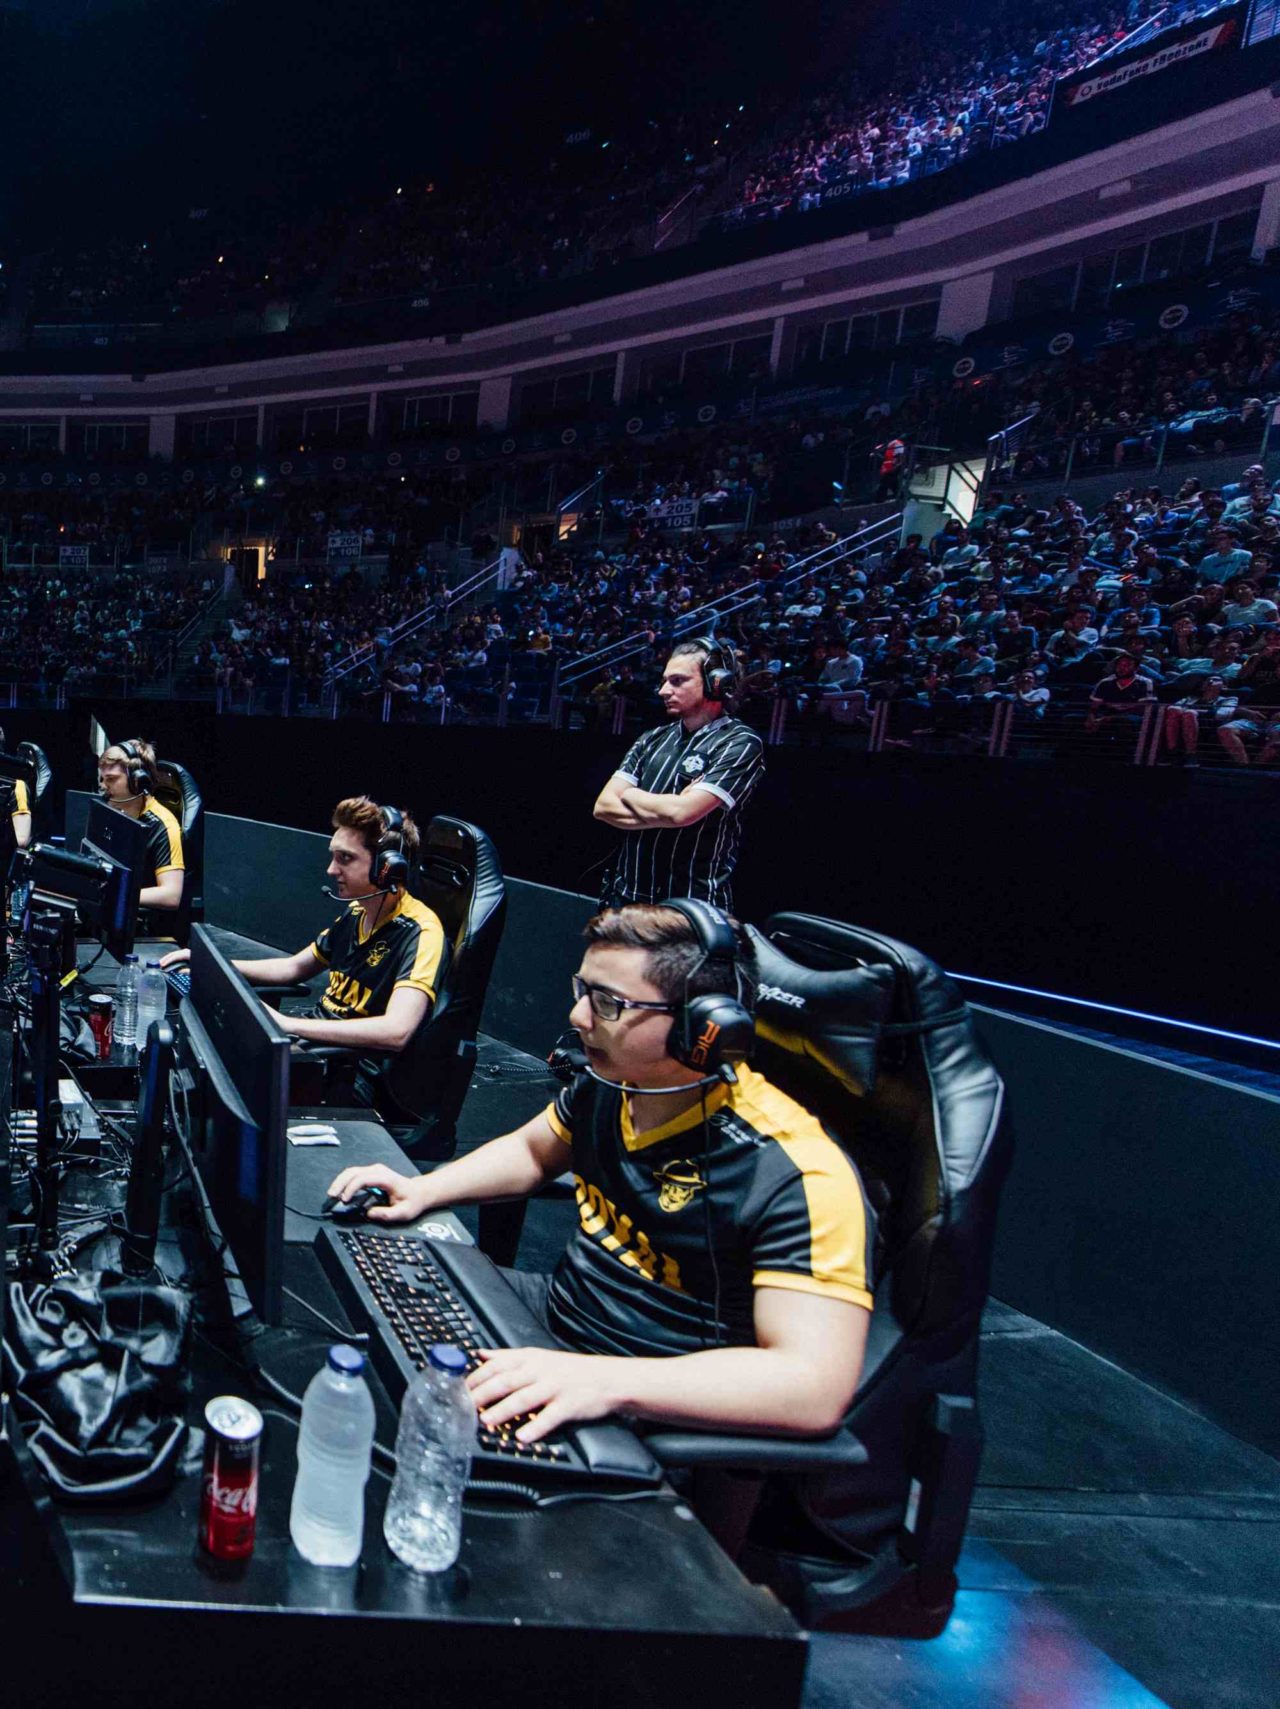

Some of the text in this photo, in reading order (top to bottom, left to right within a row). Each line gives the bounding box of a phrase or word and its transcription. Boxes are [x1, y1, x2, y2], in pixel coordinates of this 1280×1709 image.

[825, 183, 851, 198] 405
[667, 503, 693, 515] 205
[666, 516, 692, 529] 105
